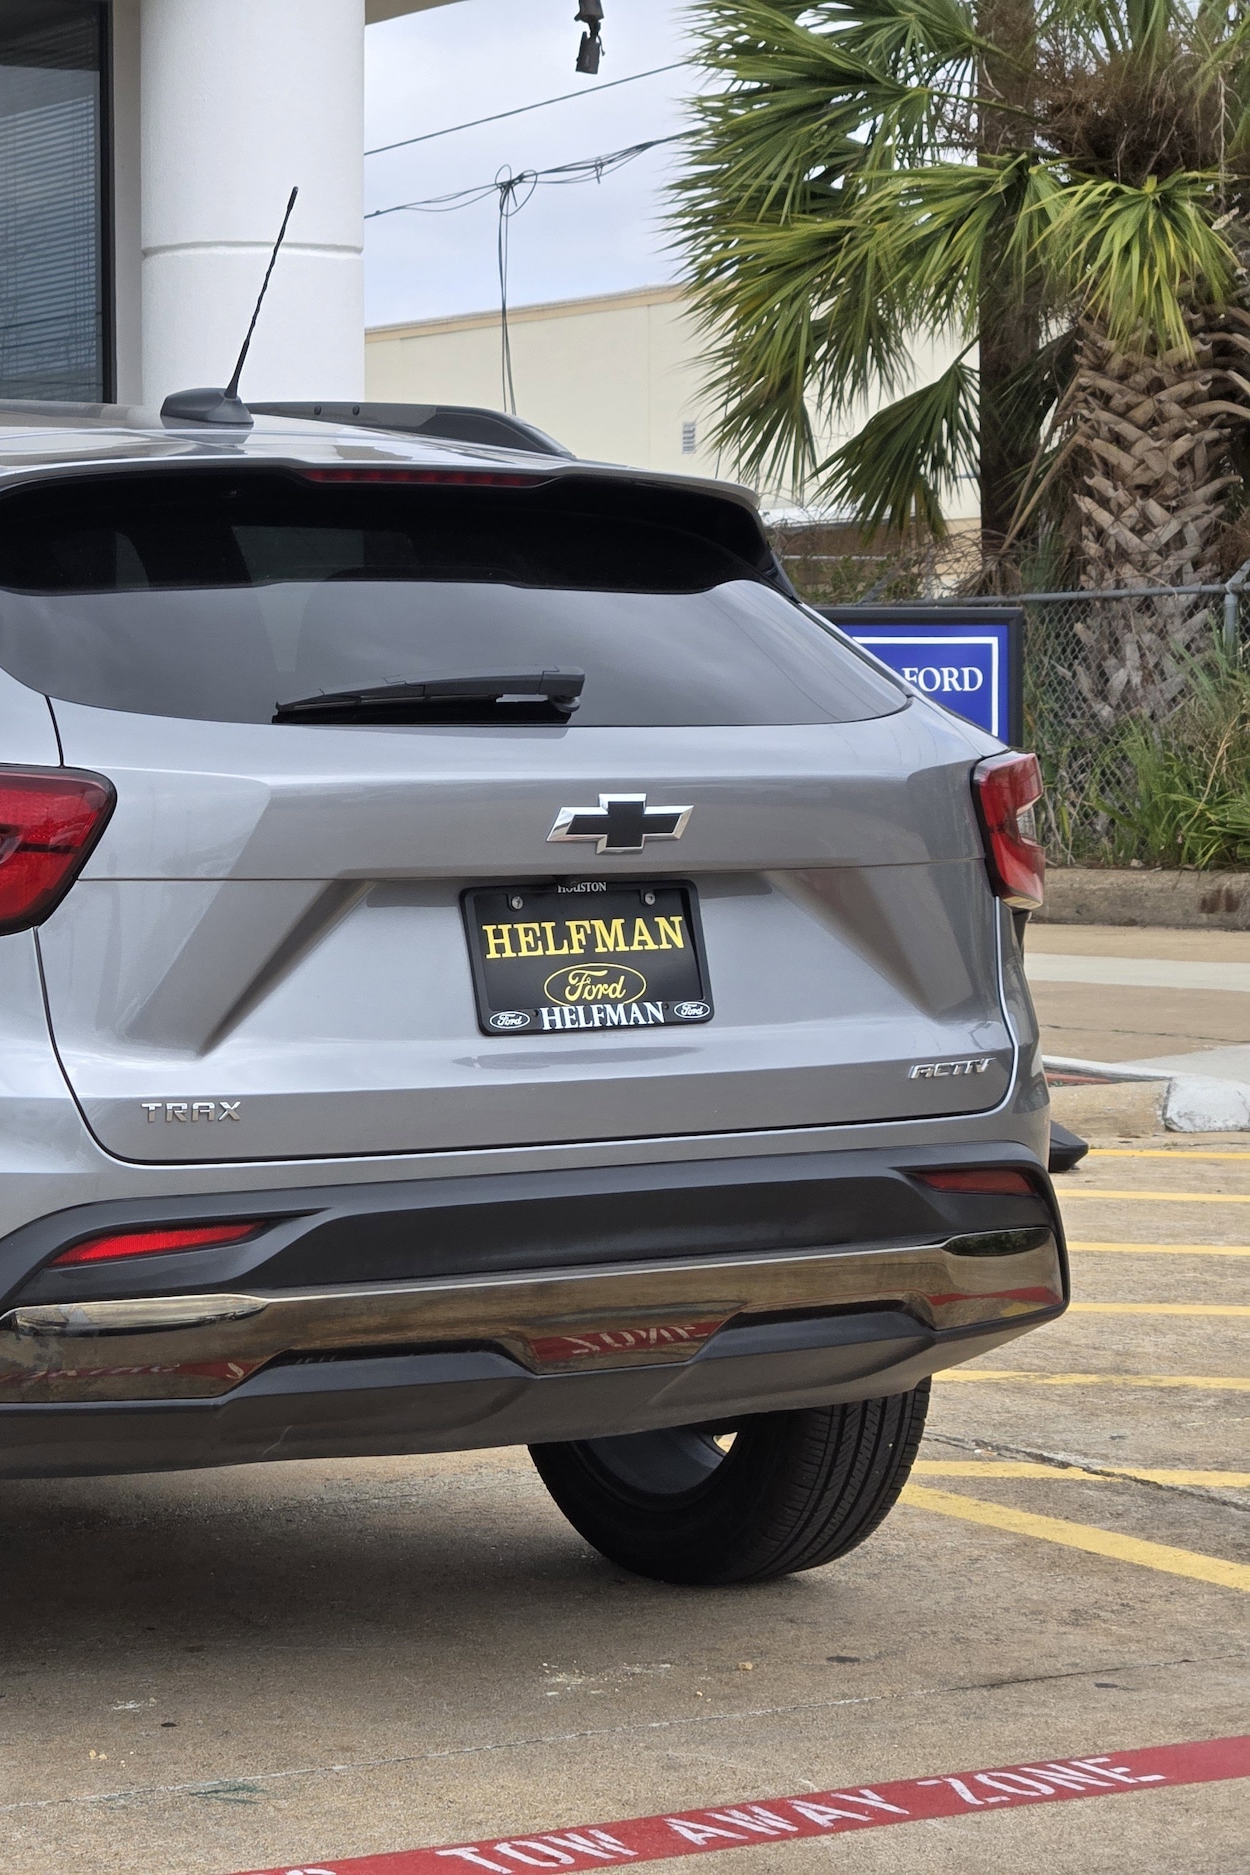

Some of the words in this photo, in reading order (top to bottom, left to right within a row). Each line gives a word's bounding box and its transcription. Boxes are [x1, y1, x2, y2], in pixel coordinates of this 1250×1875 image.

[902, 666, 983, 692] FORD
[481, 916, 685, 959] HELFMAN
[564, 969, 626, 1001] Ford
[539, 1001, 666, 1031] HELFMAN
[141, 1101, 241, 1122] TRAX
[435, 1829, 639, 1875] TOW
[664, 1788, 911, 1846] AWAY
[917, 1756, 1166, 1806] ZONE
